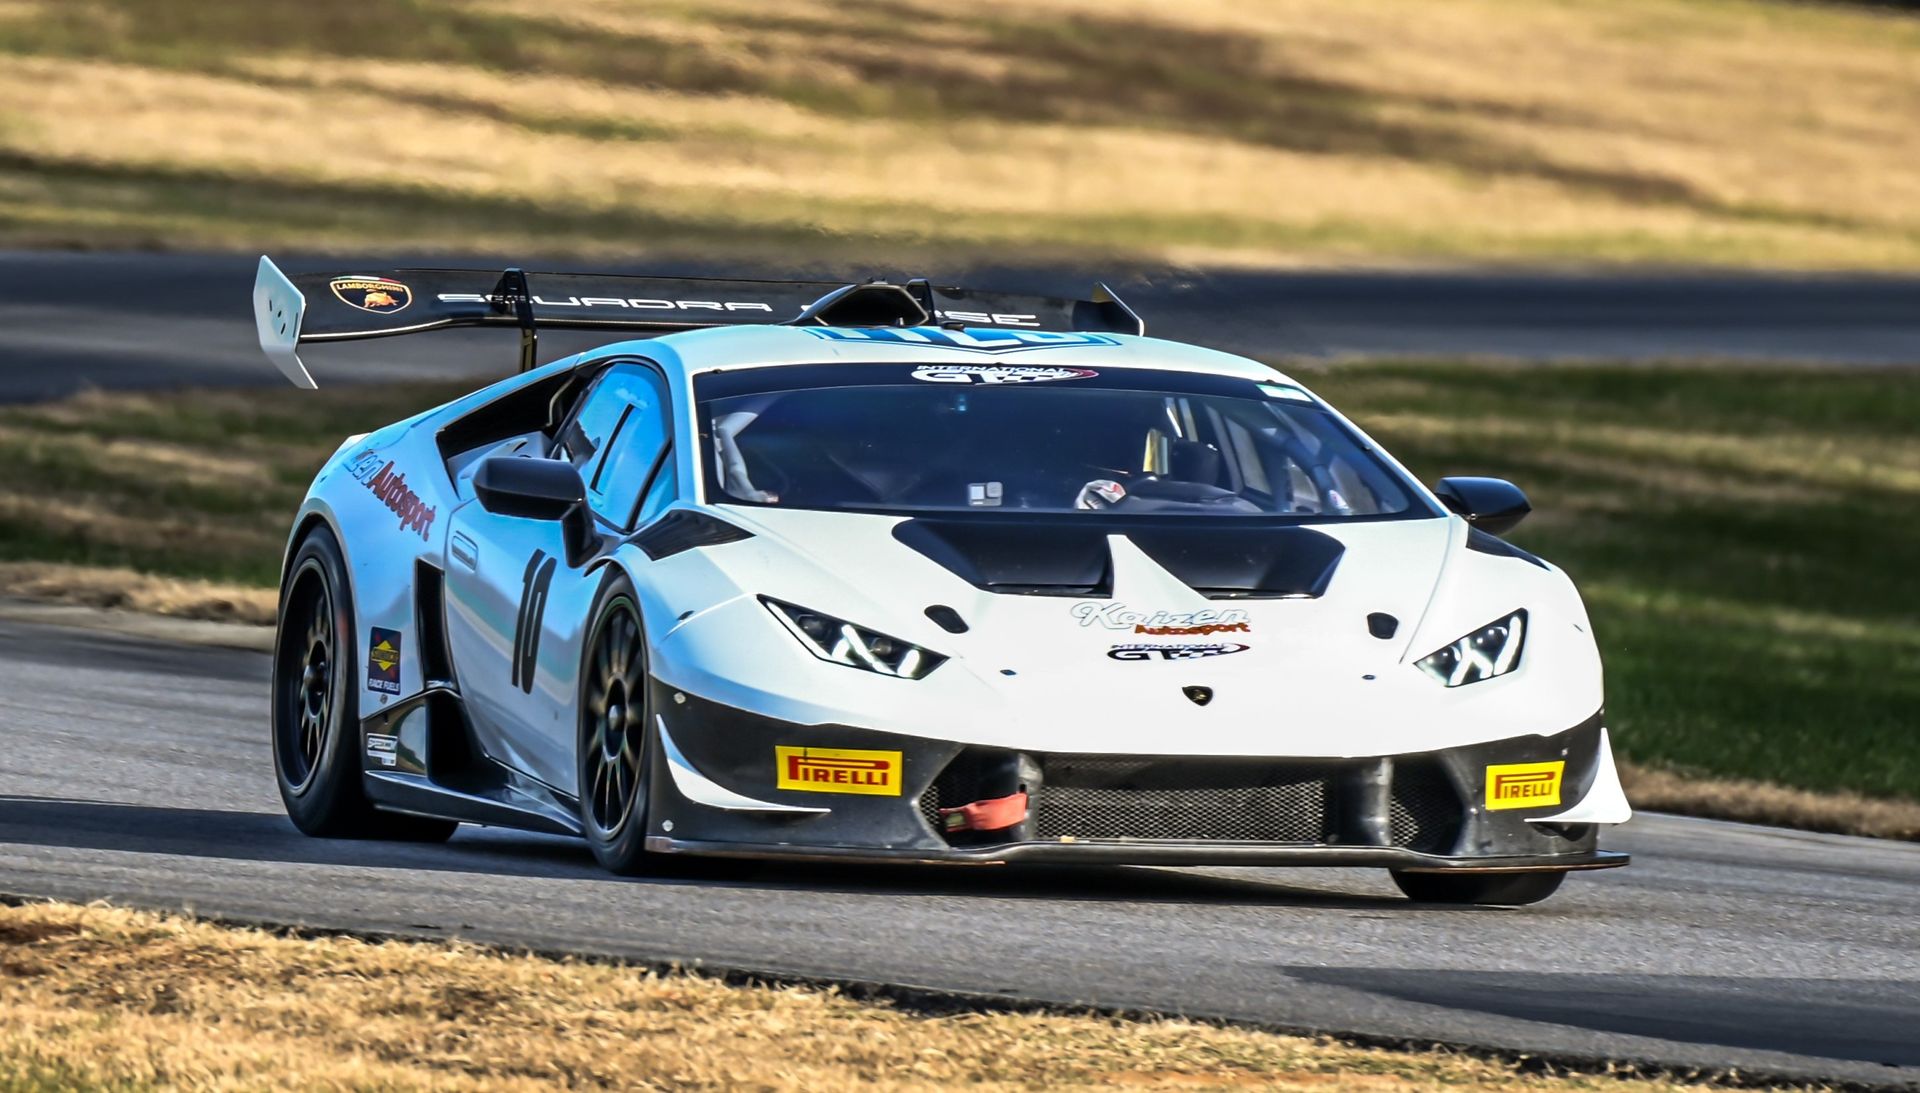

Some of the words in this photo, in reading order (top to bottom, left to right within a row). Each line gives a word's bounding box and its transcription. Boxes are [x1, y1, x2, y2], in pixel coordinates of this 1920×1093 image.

[917, 365, 1065, 373] INTERNATIONAL
[366, 460, 436, 542] Autosport
[512, 548, 557, 695] 10
[1070, 601, 1250, 630] Kaizen
[368, 678, 383, 689] RACE
[384, 680, 400, 692] FUELS
[787, 755, 891, 786] PIRELLI
[1495, 771, 1555, 799] PIRELLI
